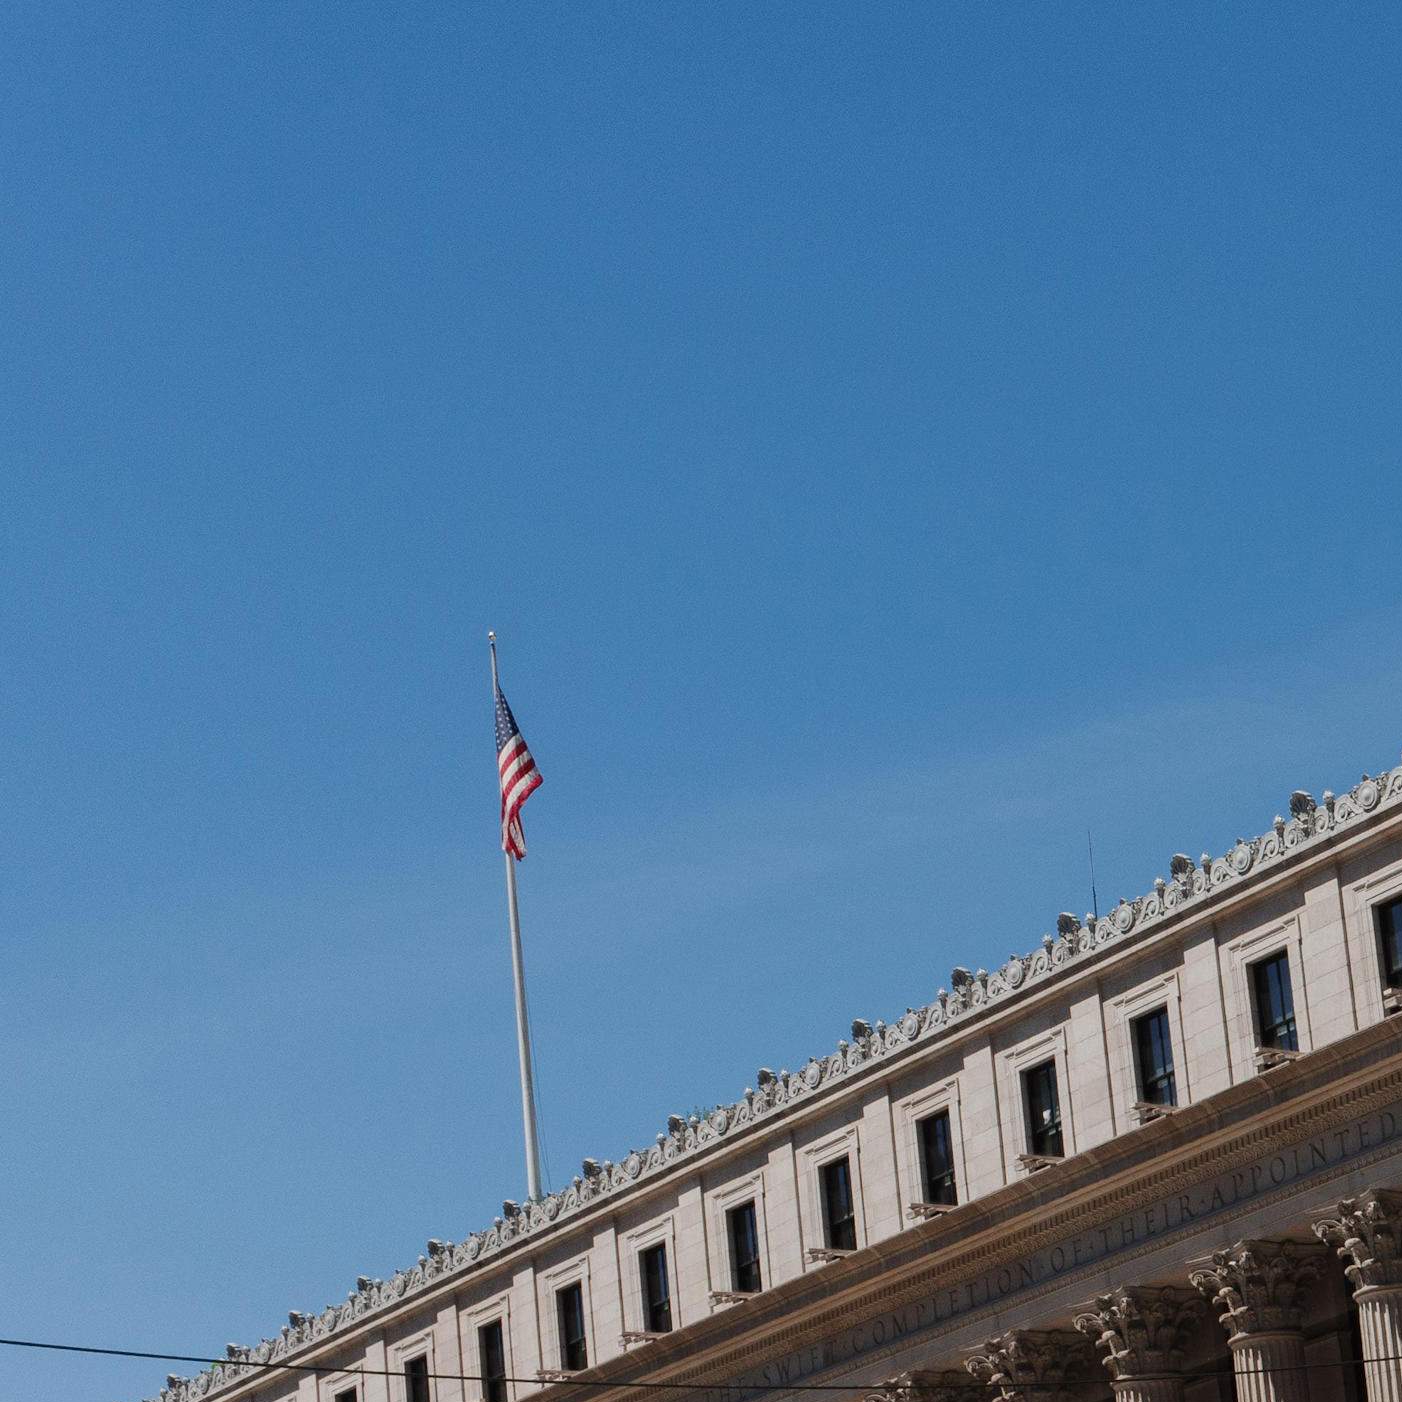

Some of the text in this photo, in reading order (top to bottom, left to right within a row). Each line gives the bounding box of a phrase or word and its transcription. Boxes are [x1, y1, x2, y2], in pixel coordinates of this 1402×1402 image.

[762, 1339, 838, 1382] SWIFT
[853, 1260, 1036, 1354] COMPLETION
[1050, 1236, 1092, 1275] OF
[1100, 1191, 1198, 1248] THEIR
[1210, 1109, 1398, 1212] APPOINTED
